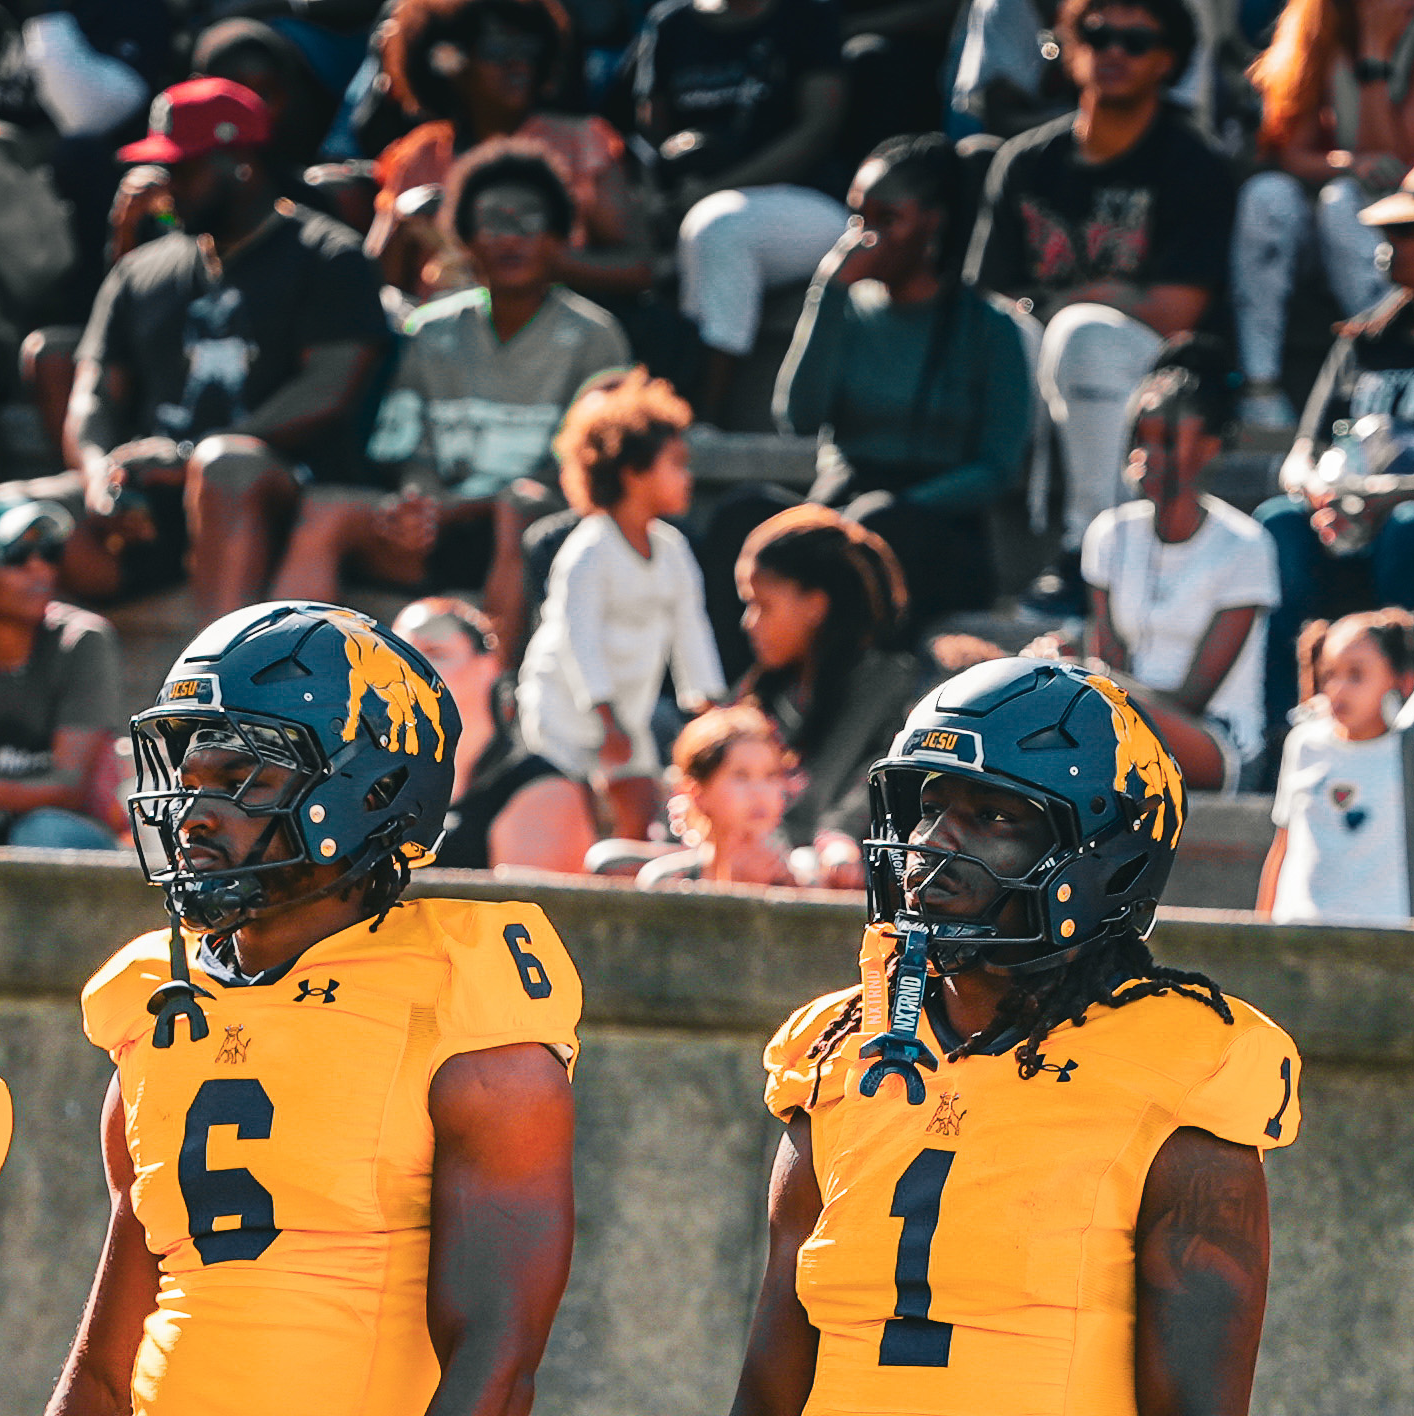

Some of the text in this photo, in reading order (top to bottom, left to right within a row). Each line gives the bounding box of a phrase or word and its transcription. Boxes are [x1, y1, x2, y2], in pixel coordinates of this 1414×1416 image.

[168, 681, 197, 698] JCSU
[921, 731, 958, 750] JCSU
[502, 923, 553, 1000] 6
[867, 970, 883, 1025] NXTRND
[892, 975, 922, 1032] NXTRND
[1263, 1056, 1291, 1141] 1
[178, 1078, 283, 1266] 6
[878, 1147, 957, 1368] 1
